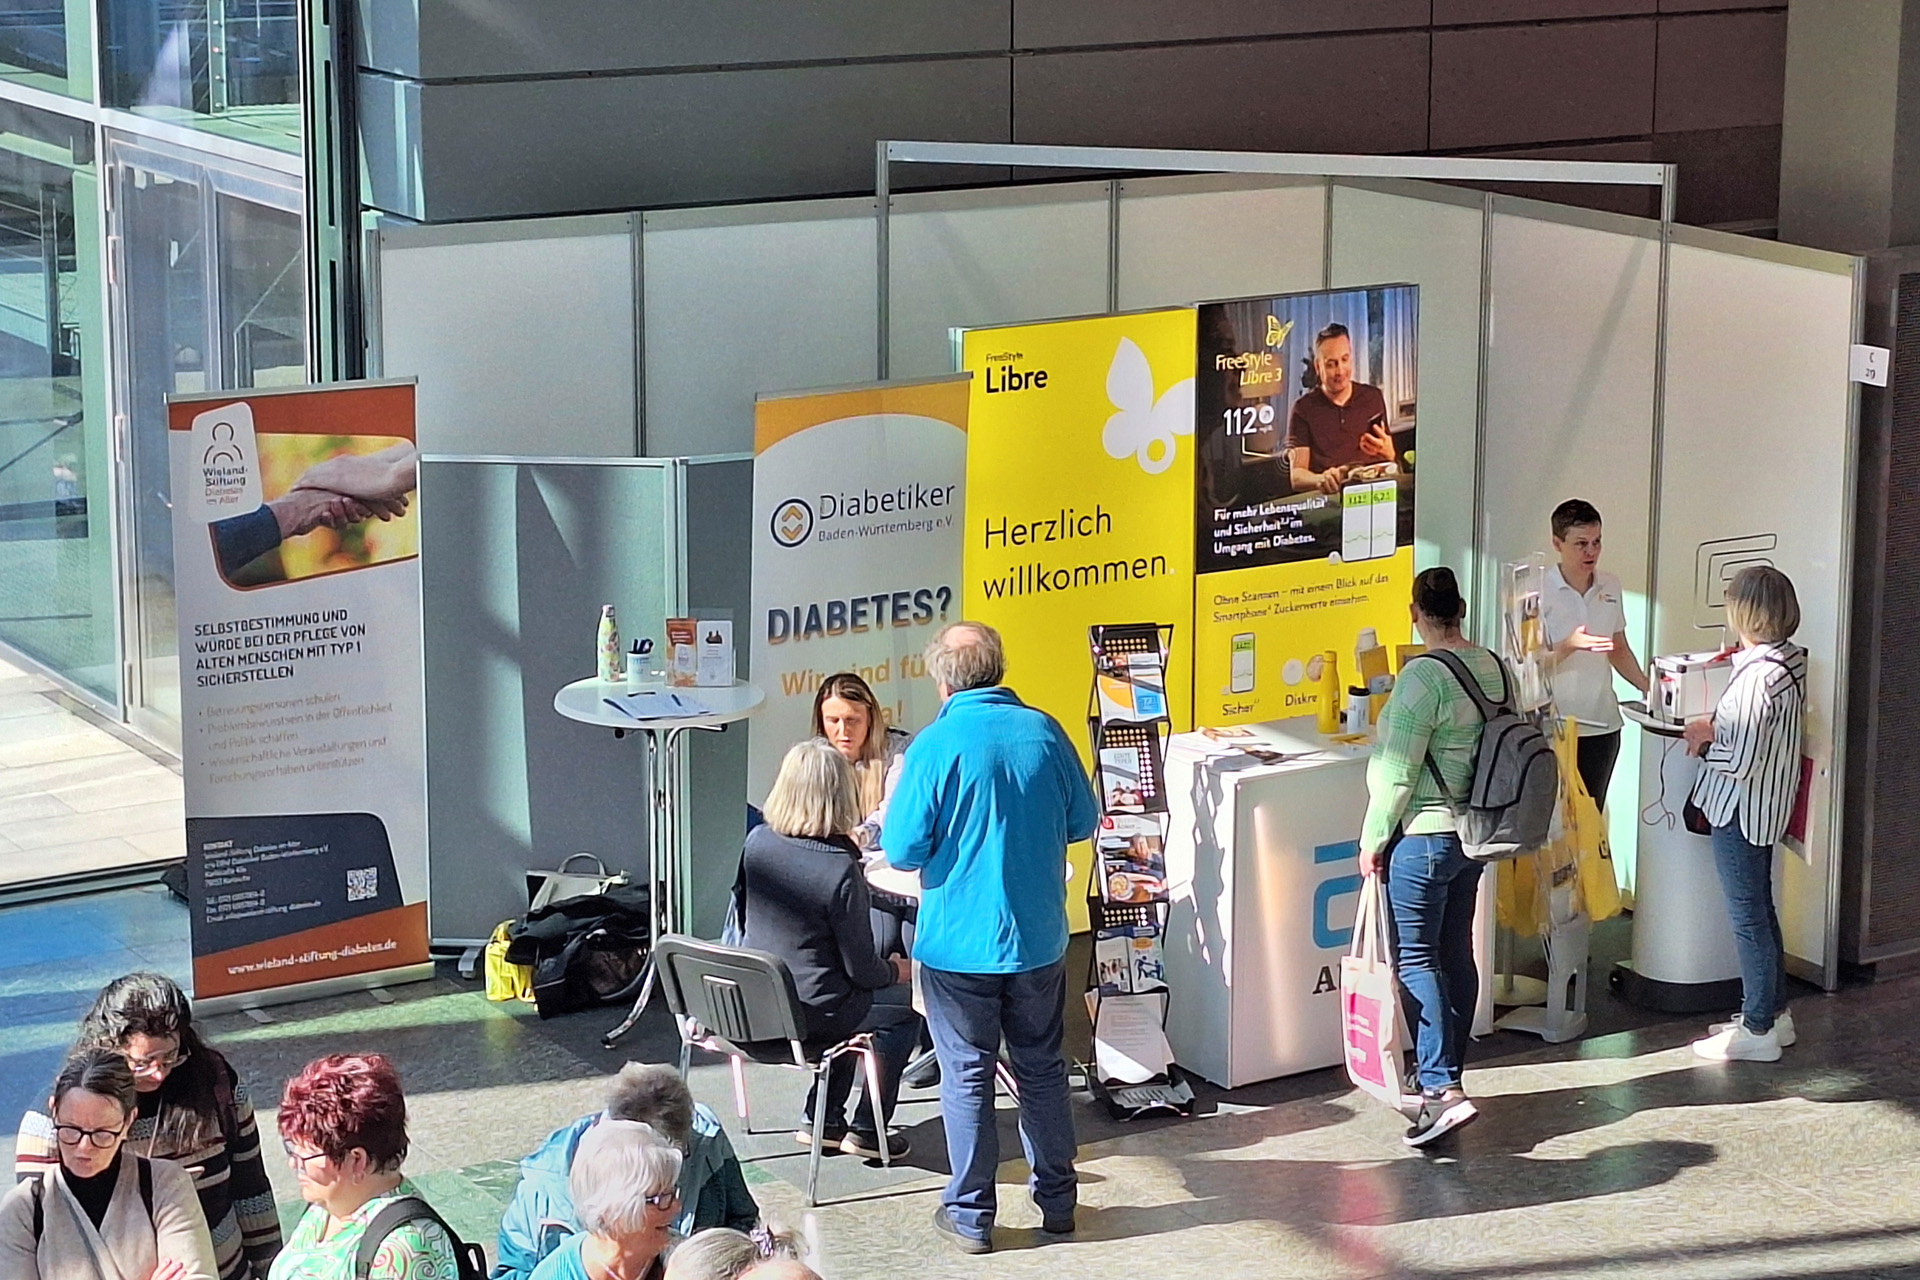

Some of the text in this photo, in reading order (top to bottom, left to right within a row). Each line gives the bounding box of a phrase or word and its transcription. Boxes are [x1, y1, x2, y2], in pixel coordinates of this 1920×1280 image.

[1215, 350, 1273, 371] FreeStyle
[986, 365, 1048, 393] Libre
[1240, 368, 1283, 386] Libre 3
[1223, 407, 1257, 436] 112
[819, 482, 956, 520] Diabetiker
[1214, 508, 1231, 521] Für
[1232, 505, 1258, 519] mehr
[818, 515, 955, 542] Baden-Württemberg e.V.
[985, 504, 1111, 549] Herzlich
[1213, 524, 1232, 538] und
[1213, 533, 1316, 557] Umgang mit Diabetes.
[1213, 595, 1239, 606] Ohne
[1290, 584, 1304, 595] mit
[1307, 582, 1333, 593] einem
[1336, 578, 1357, 589] Blick
[1359, 574, 1374, 586] auf
[767, 586, 952, 645] DIABETES?
[1274, 600, 1328, 615] Zuckerwerte
[194, 609, 348, 637] SELBSTBESTIMMUNG UND
[195, 623, 366, 654] WÜRDE BEI DER PFLEGE VON
[196, 655, 235, 670] ALTEN
[238, 648, 304, 666] MENSCHEN
[307, 645, 326, 658] MIT
[330, 642, 354, 656] TYP
[197, 665, 294, 687] SICHERSTELLEN
[781, 668, 824, 697] Wir
[900, 653, 927, 680] fü
[316, 708, 331, 720] der
[227, 938, 398, 975] www.wieland-stiftung-diabetes.de
